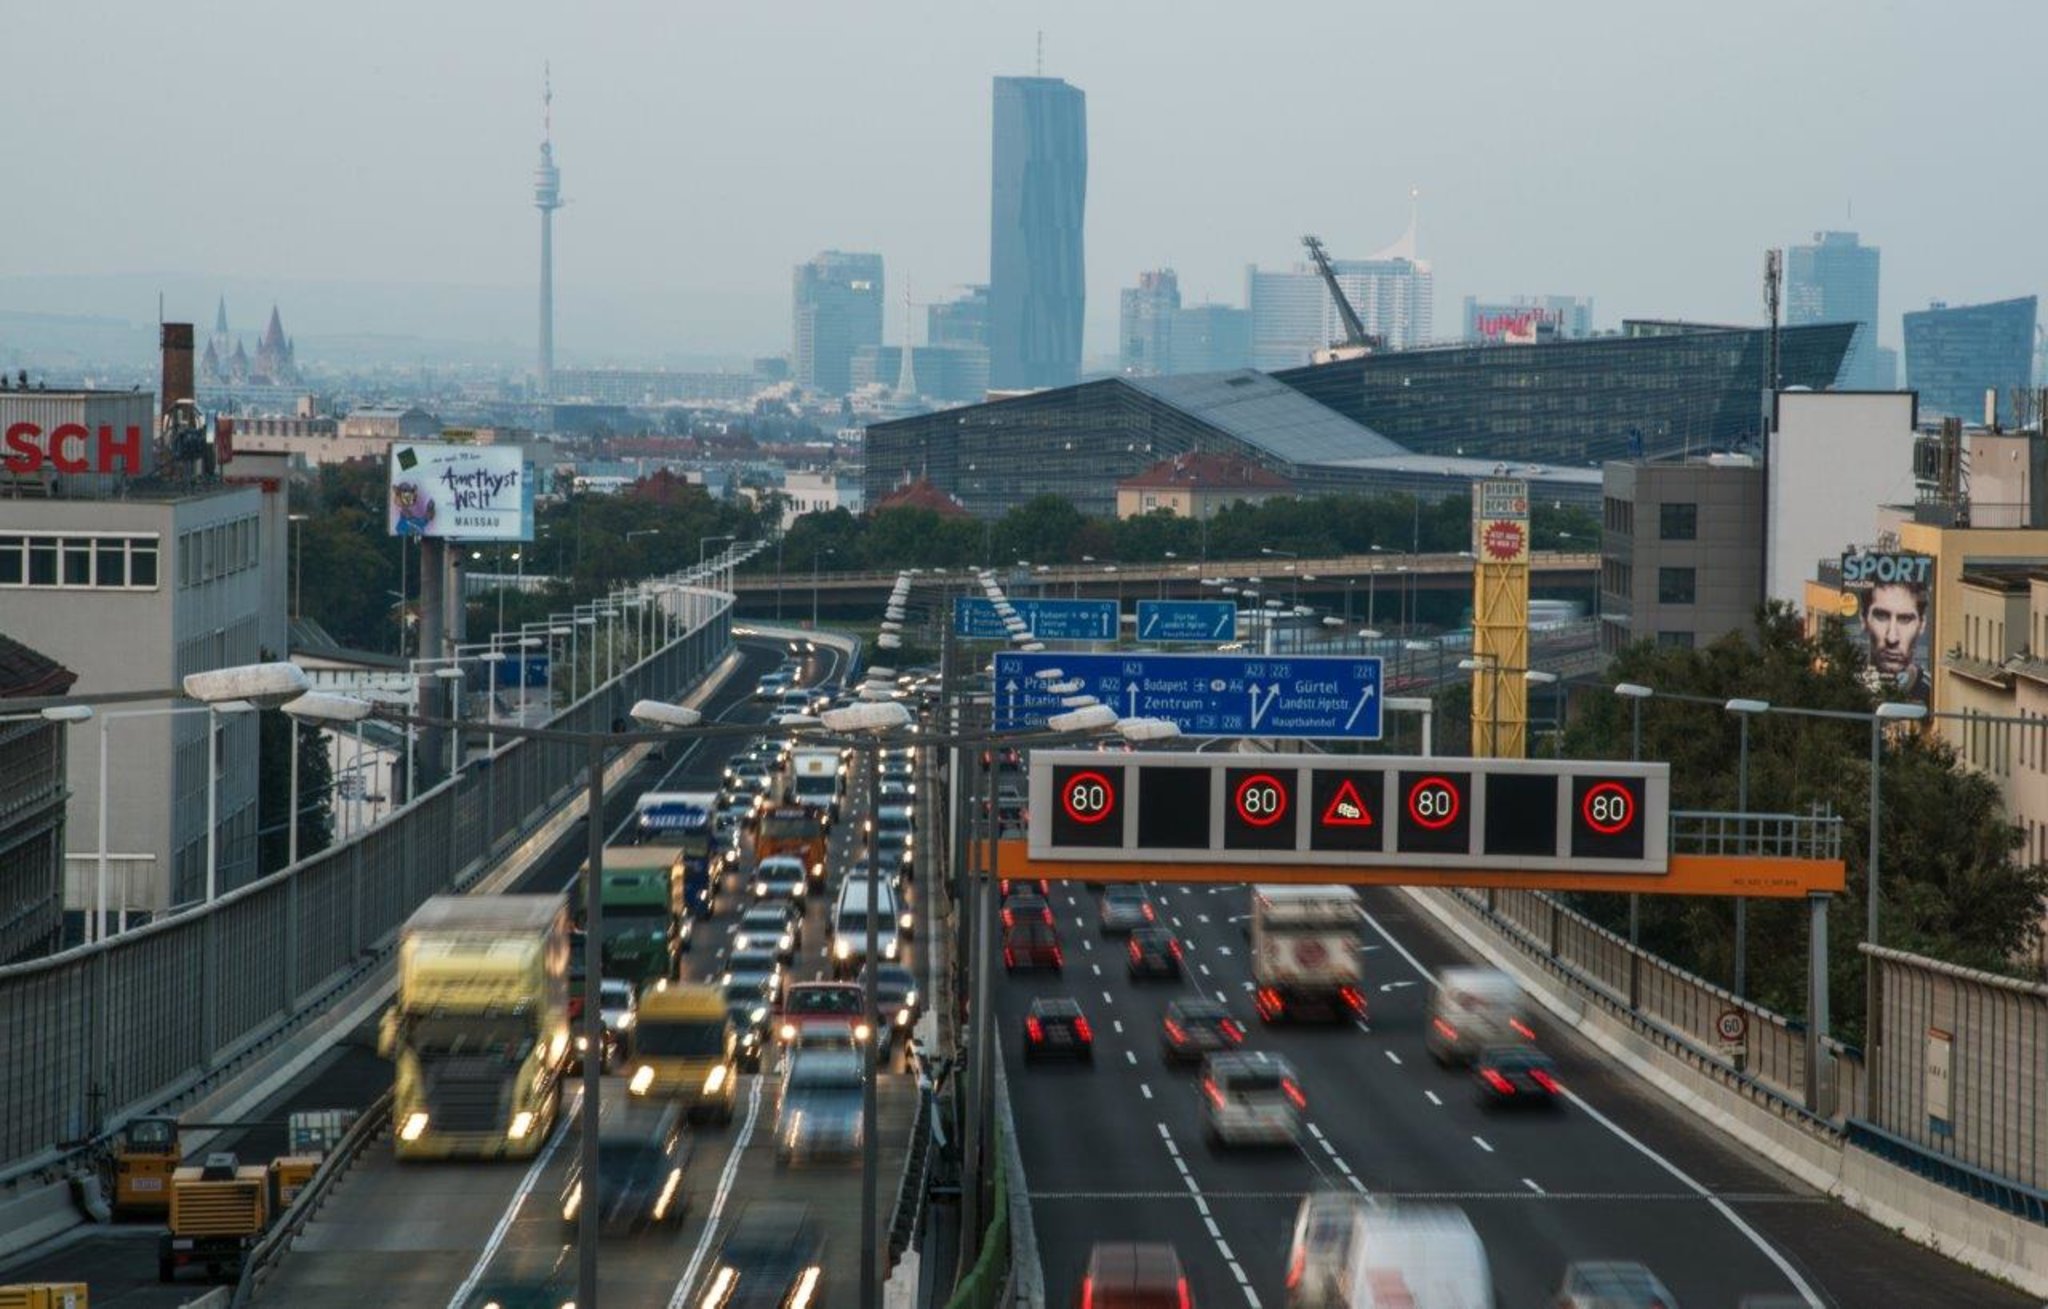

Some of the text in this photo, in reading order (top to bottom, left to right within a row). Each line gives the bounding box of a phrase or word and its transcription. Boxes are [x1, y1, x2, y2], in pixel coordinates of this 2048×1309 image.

[5, 422, 142, 475] SCH
[440, 465, 519, 496] Amethyst
[454, 487, 490, 511] Welt
[454, 516, 500, 527] MAISSAU
[1843, 554, 1932, 582] SPORT
[1143, 679, 1187, 693] Budapest
[1295, 680, 1338, 694] Gürtel
[1144, 696, 1203, 710] Zentrum
[1272, 716, 1336, 728] Hauptbahnhof
[1072, 785, 1104, 811] 80
[1245, 788, 1276, 813] 80
[1418, 791, 1449, 816] 80
[1593, 796, 1625, 821] 80
[1724, 1018, 1740, 1034] 60
